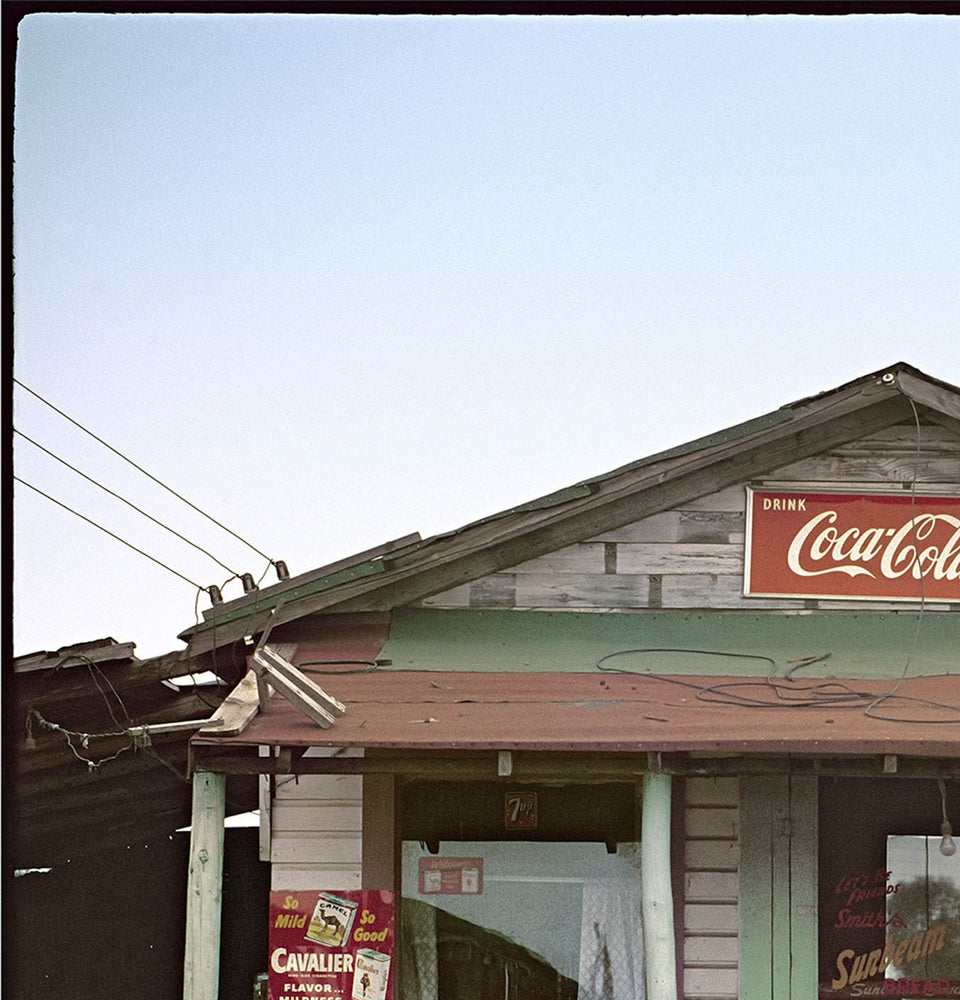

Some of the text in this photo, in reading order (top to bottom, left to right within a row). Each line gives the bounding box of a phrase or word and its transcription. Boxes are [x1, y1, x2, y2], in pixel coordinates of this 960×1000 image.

[763, 498, 807, 511] DRINK
[282, 895, 299, 910] So
[319, 903, 348, 917] CAMEL
[275, 914, 308, 929] Mild
[360, 910, 376, 924] So
[354, 928, 389, 942] Good
[271, 947, 354, 974] CAVALIER
[832, 924, 948, 990] Sunbeam
[884, 978, 951, 995] BREAD
